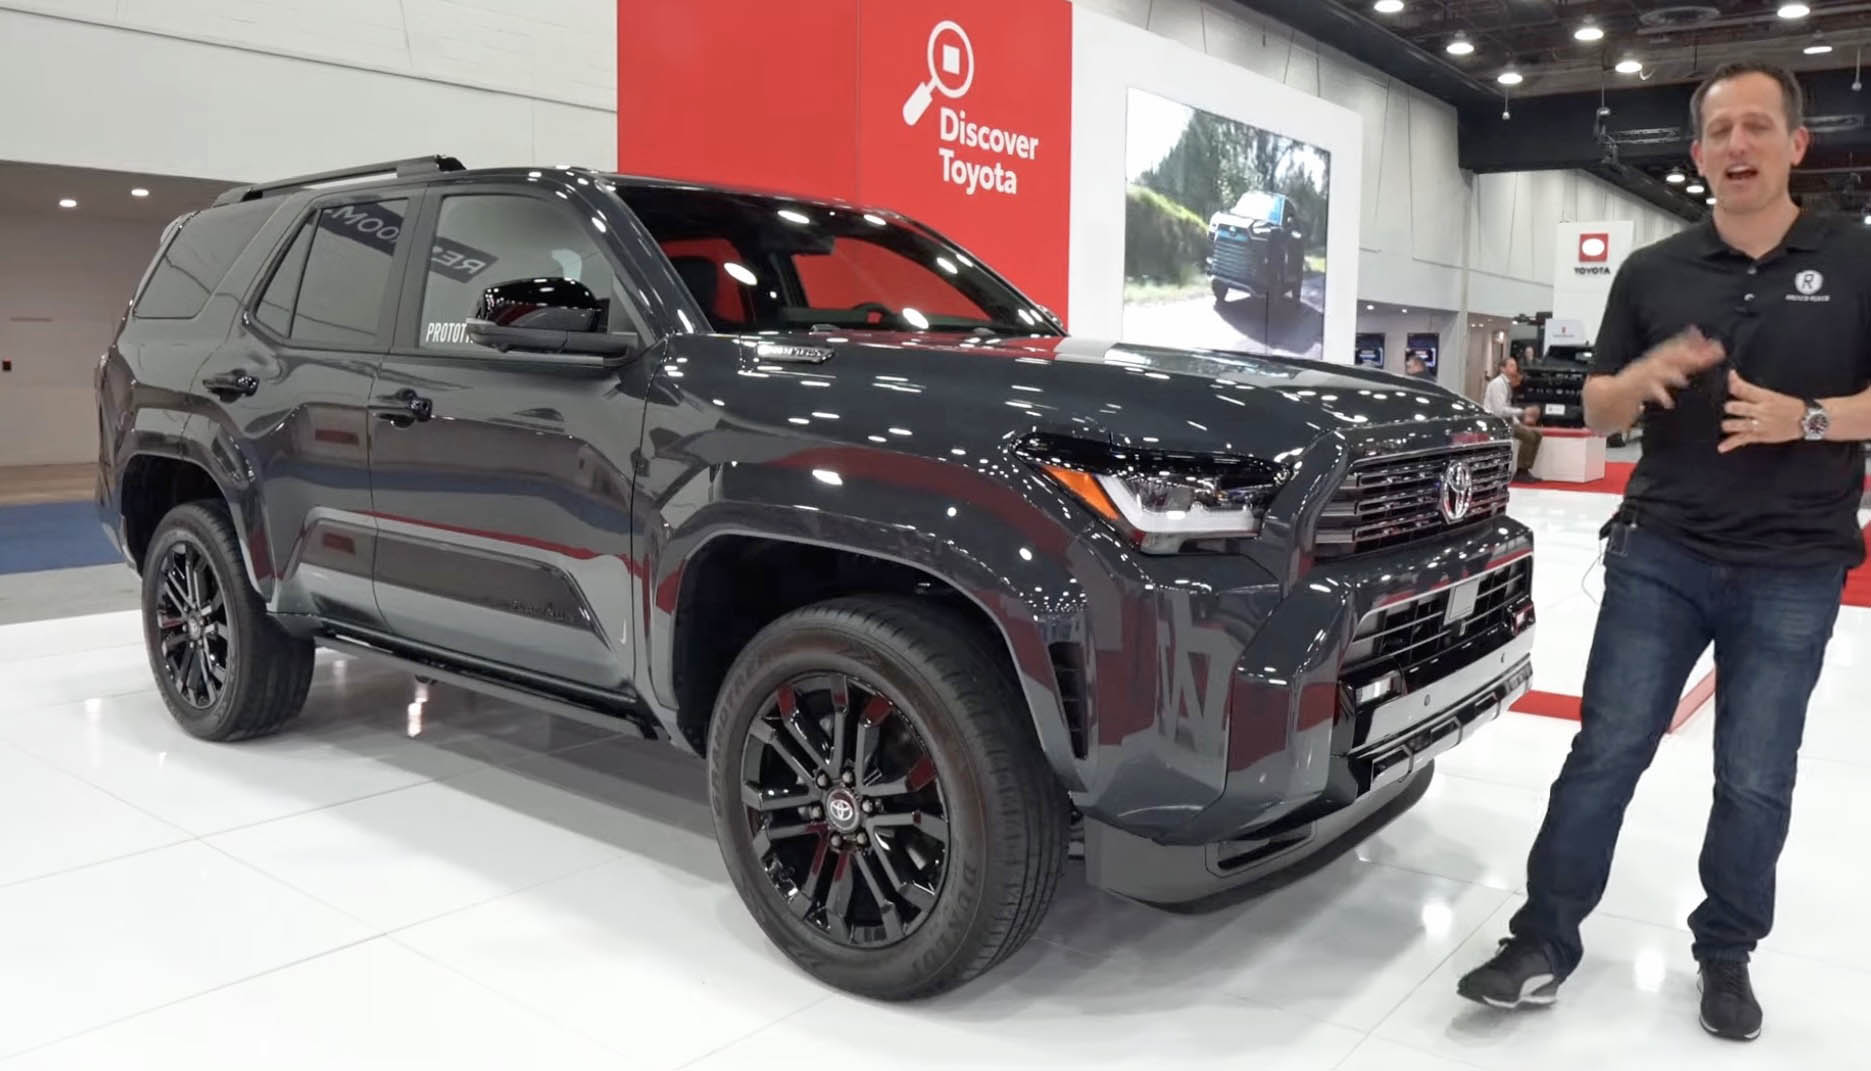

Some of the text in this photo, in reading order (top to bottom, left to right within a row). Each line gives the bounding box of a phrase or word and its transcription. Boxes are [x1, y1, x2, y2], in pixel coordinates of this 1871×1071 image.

[940, 107, 1039, 160] Discover
[939, 147, 1017, 195] Toyota
[1574, 266, 1610, 275] TOYOTA
[426, 322, 474, 344] PROTOT
